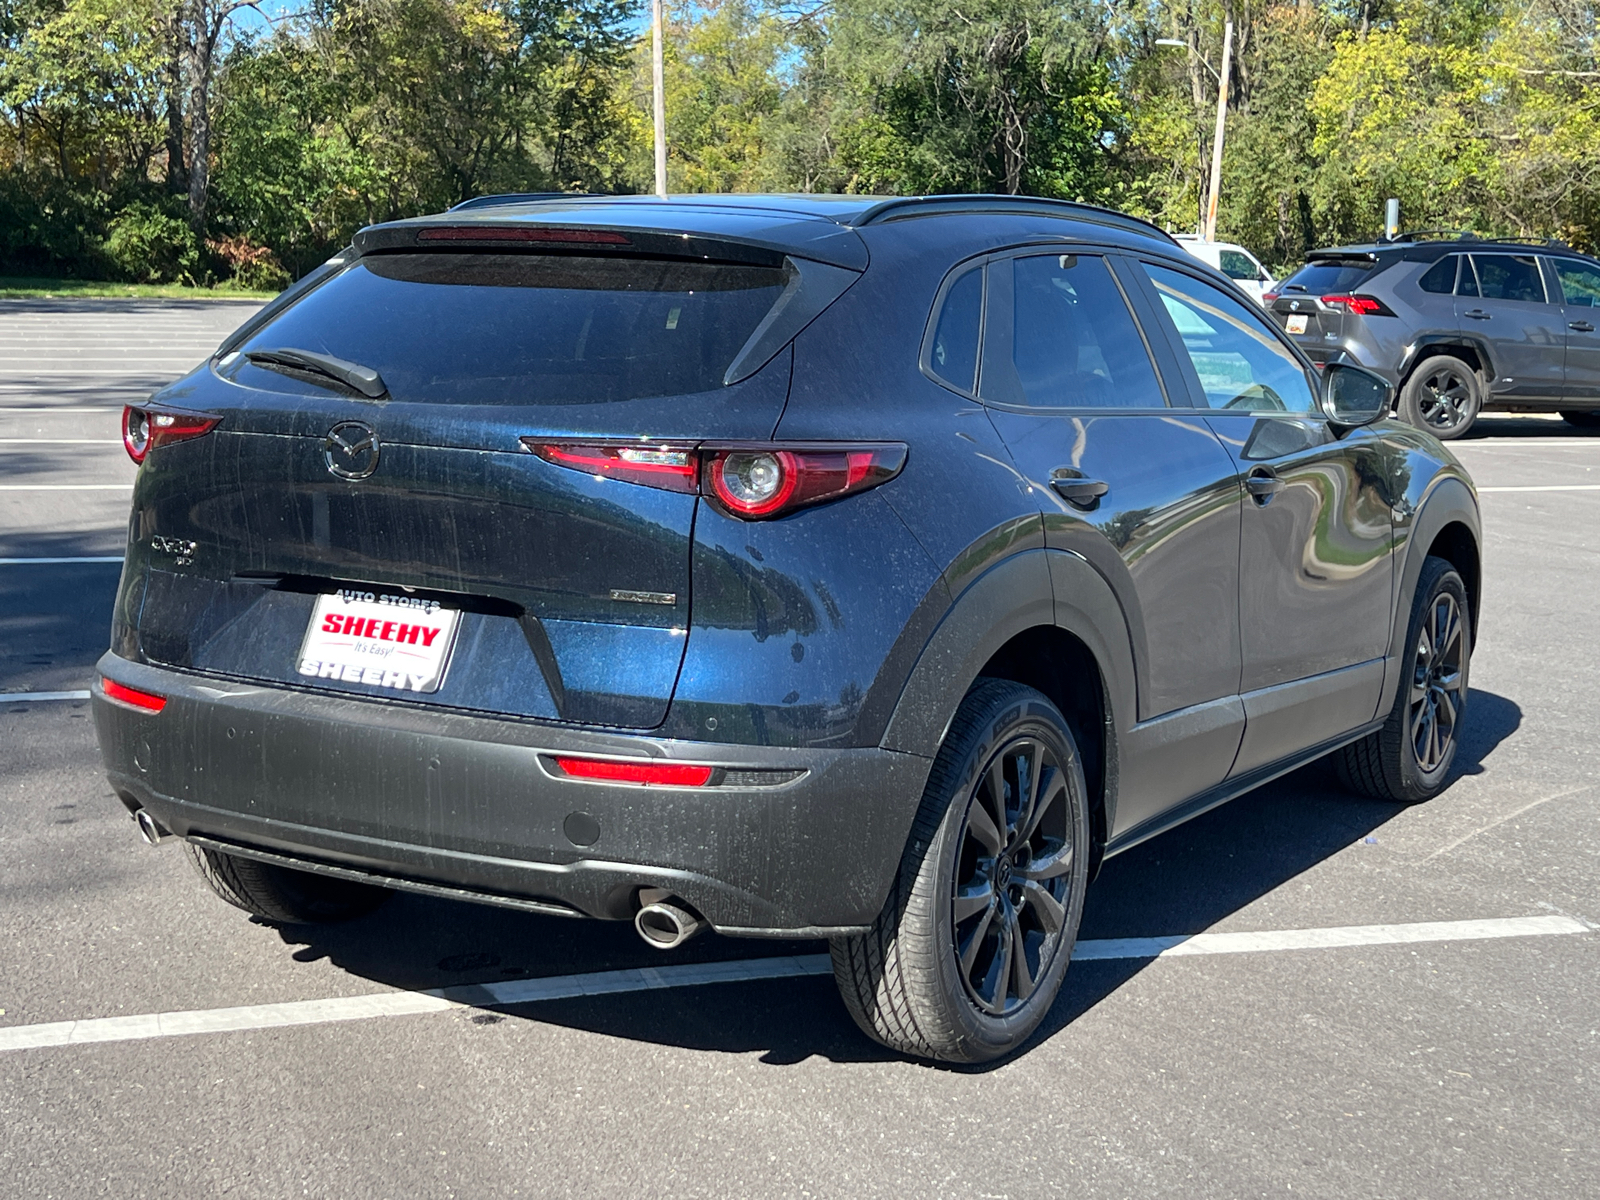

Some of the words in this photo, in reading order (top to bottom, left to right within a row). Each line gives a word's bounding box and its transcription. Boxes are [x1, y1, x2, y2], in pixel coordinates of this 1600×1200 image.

[336, 588, 376, 602] AUTO
[379, 594, 441, 611] STORES
[322, 613, 441, 646] SHEEHY
[354, 641, 367, 653] It's
[369, 643, 395, 659] Easy!
[299, 659, 431, 692] SHEEHY
